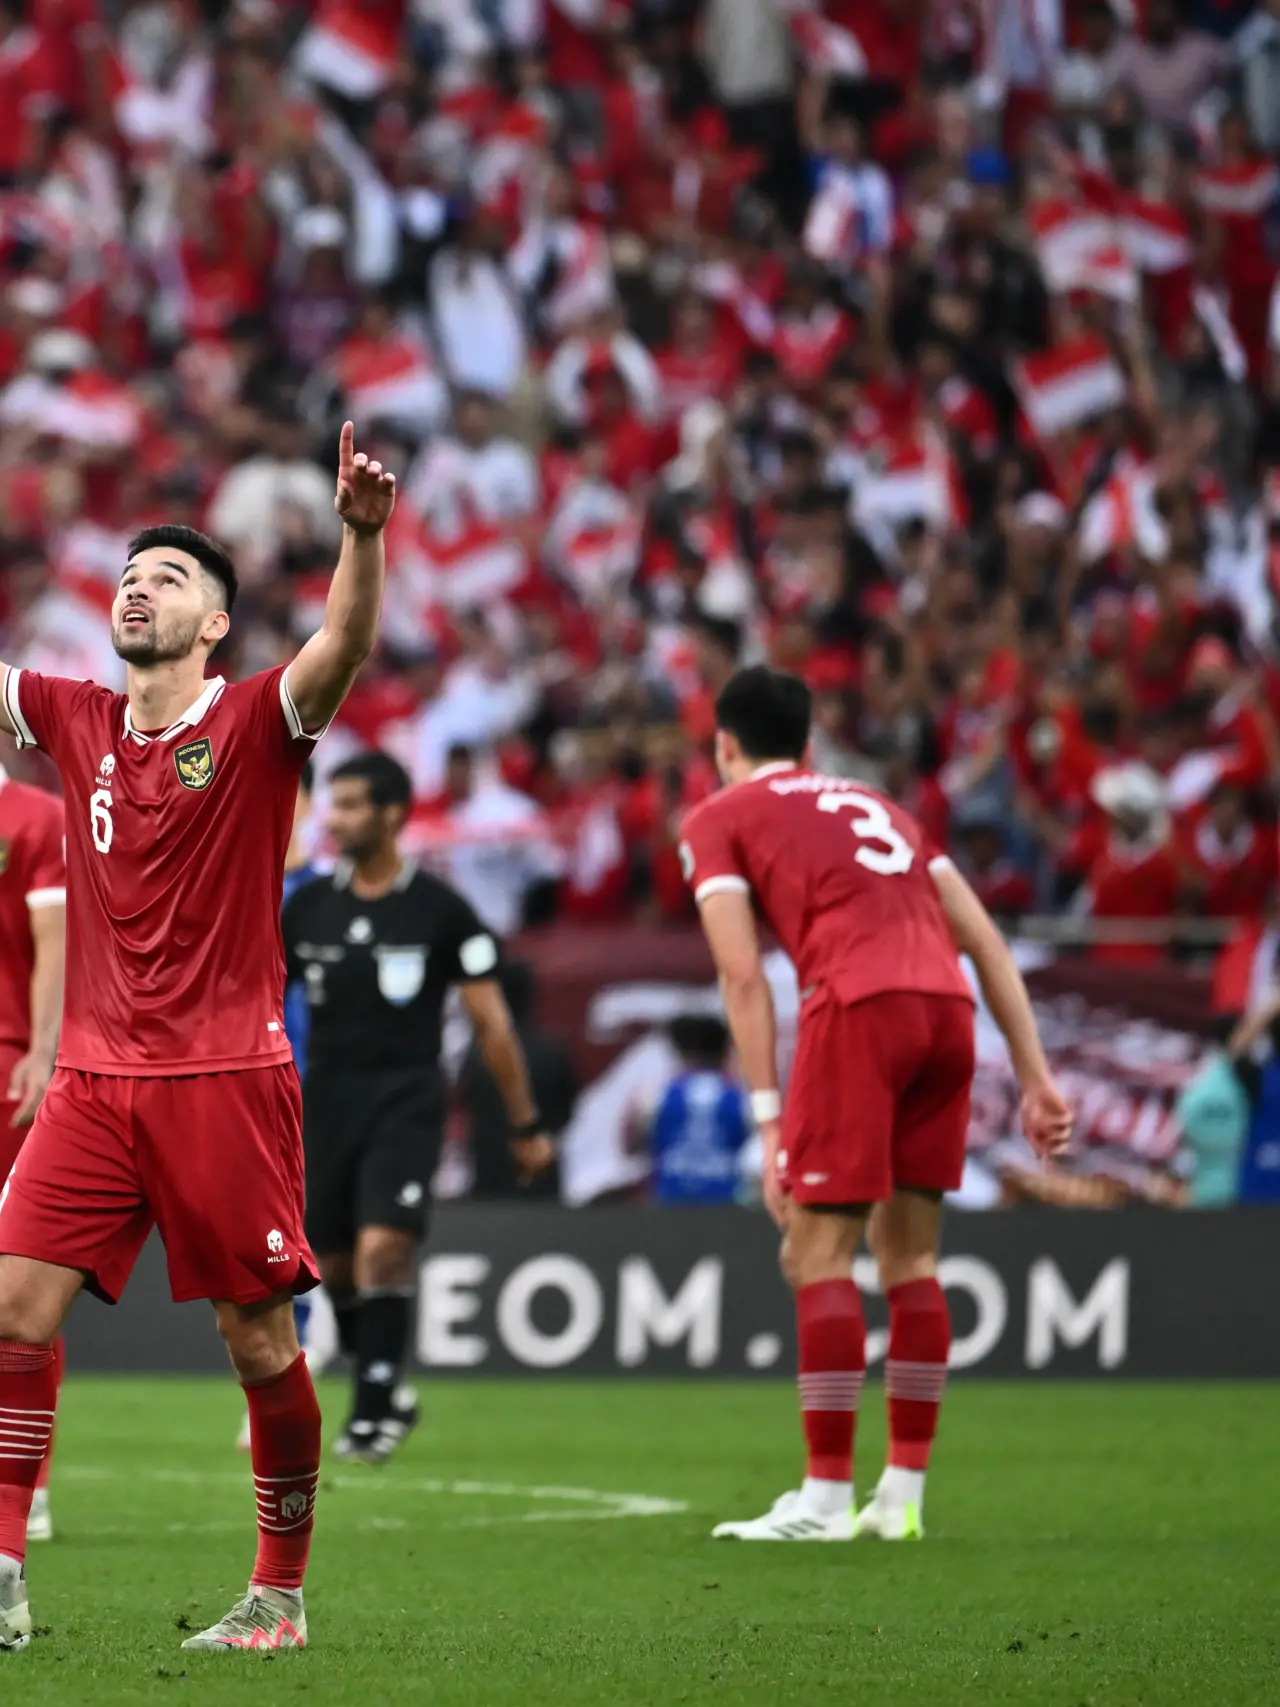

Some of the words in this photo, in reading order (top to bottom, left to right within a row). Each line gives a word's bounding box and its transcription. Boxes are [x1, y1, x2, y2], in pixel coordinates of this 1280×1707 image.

[89, 788, 114, 854] 6
[816, 791, 915, 875] 3
[267, 1253, 290, 1263] MILLS
